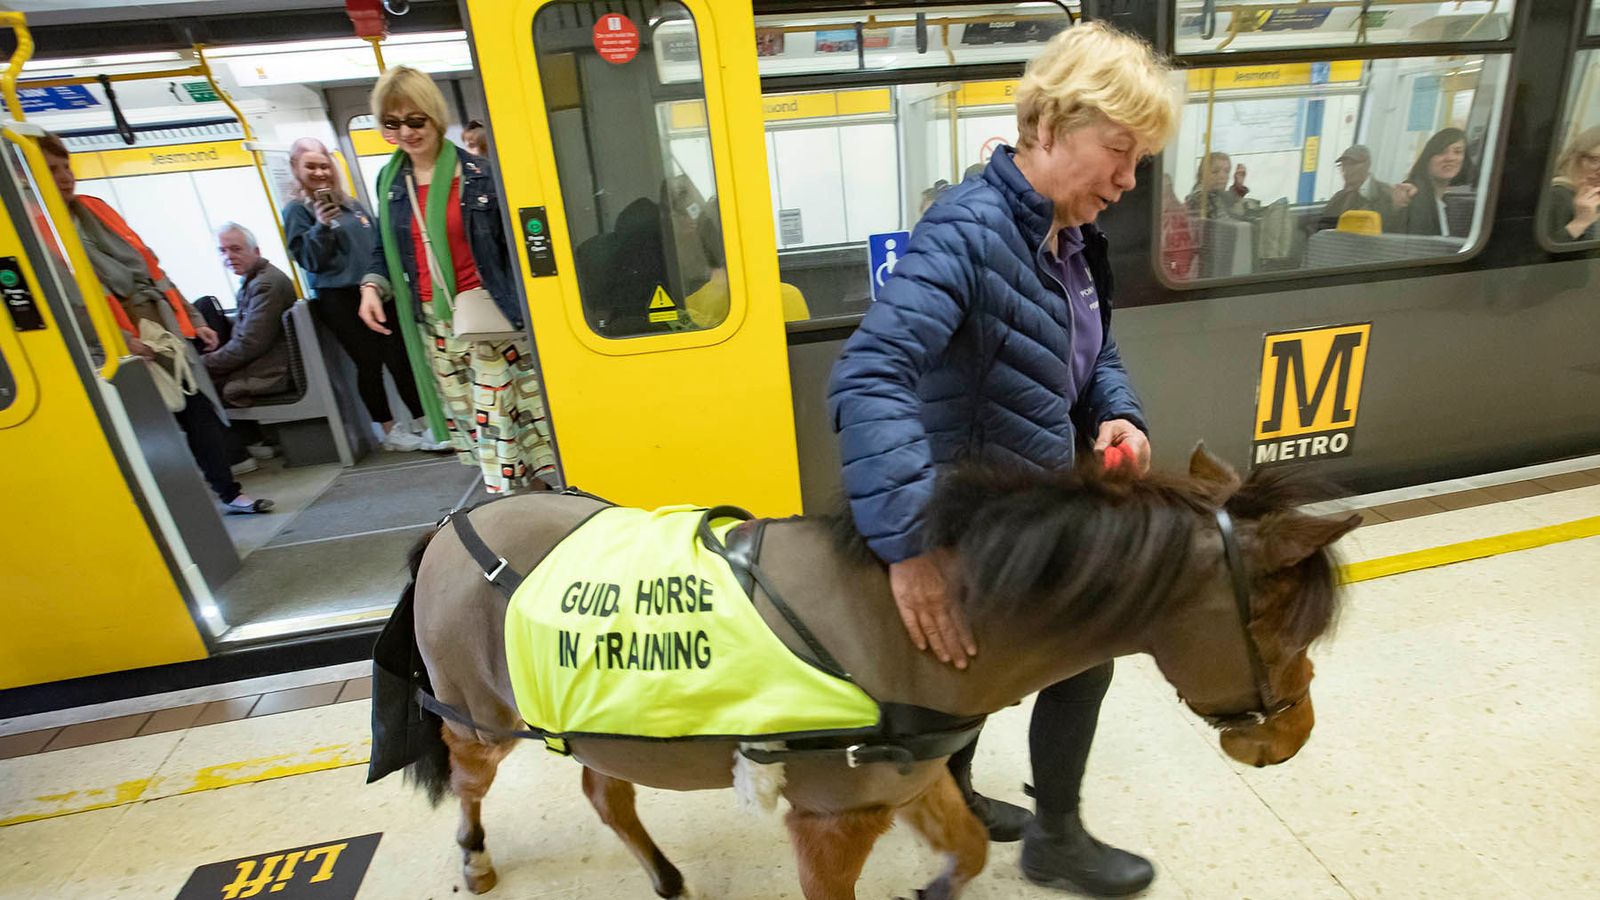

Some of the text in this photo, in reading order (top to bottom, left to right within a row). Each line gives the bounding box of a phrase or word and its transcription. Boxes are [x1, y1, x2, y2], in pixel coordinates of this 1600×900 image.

[1234, 70, 1280, 83] Jesmond
[149, 146, 220, 165] Jesmond
[1255, 432, 1350, 465] METRO
[561, 574, 714, 617] GUID HORSE
[558, 629, 711, 671] IN TRAINING
[221, 842, 348, 900] Lift
